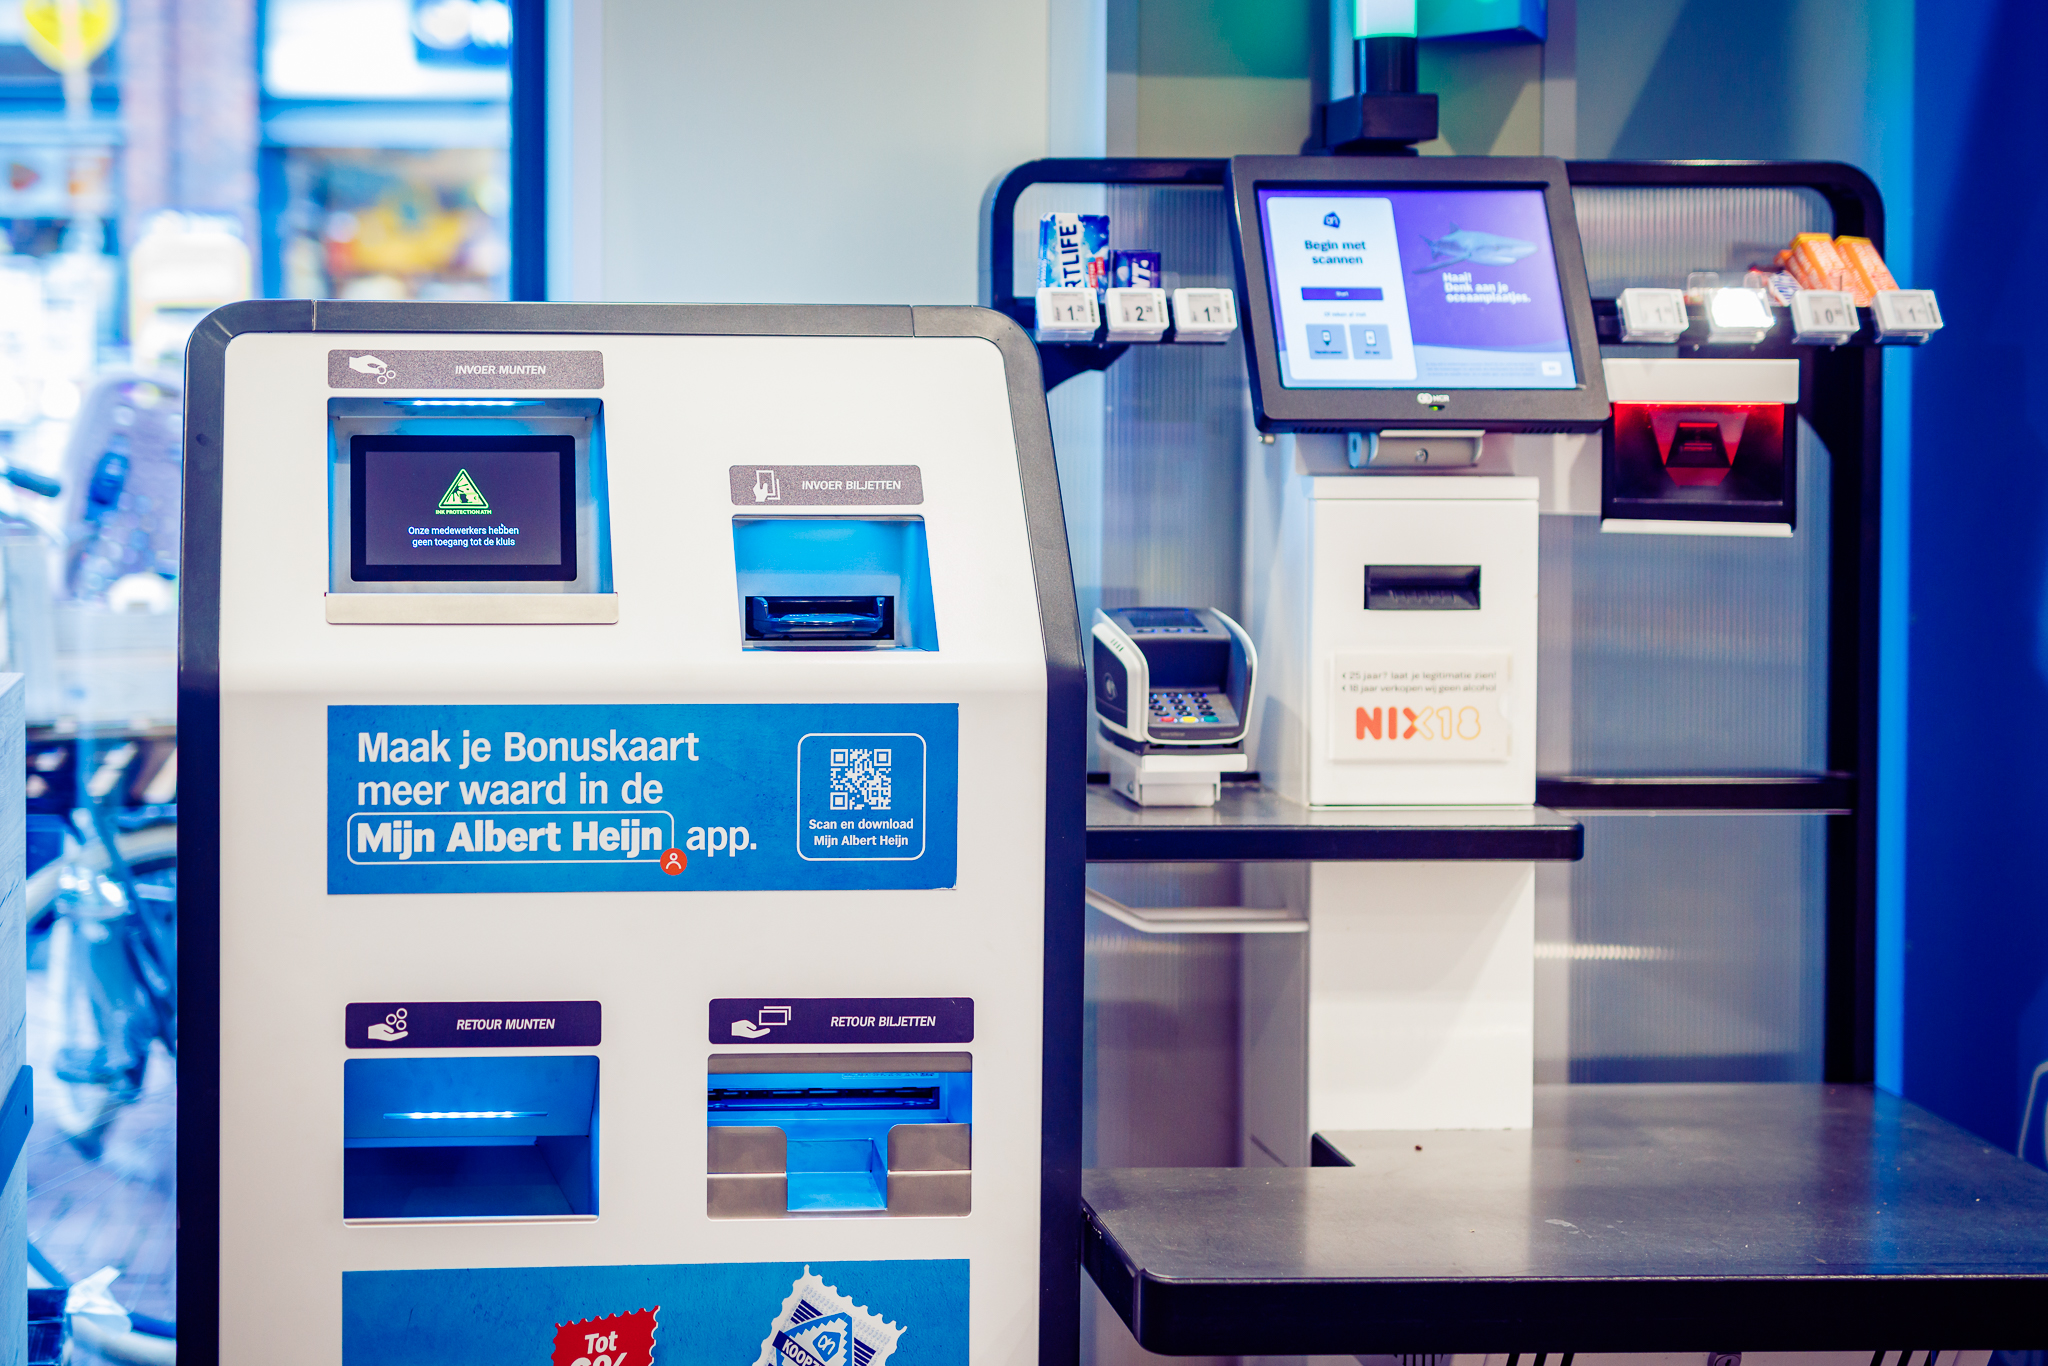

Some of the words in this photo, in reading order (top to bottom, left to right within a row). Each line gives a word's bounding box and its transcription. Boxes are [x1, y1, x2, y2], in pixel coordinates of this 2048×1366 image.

[1304, 239, 1339, 252] Begin
[1342, 240, 1366, 250] met
[1059, 224, 1081, 288] RTLIFE
[1311, 255, 1363, 265] scannen
[1444, 282, 1473, 293] Denk
[1475, 284, 1496, 293] aan
[1496, 282, 1509, 294] je
[1446, 292, 1532, 304] oceaanplaatjes.
[455, 365, 496, 375] INVOER
[499, 365, 546, 375] MUNTEN
[801, 480, 843, 490] INVOER
[845, 480, 901, 490] BILJETTEN
[408, 526, 430, 535] Onze
[431, 526, 487, 535] medewerkers
[488, 526, 520, 535] hebben
[412, 539, 433, 548] geen
[434, 538, 469, 548] toegang
[470, 538, 483, 546] tot
[483, 537, 495, 546] de
[495, 537, 516, 546] kluis
[1350, 671, 1361, 679] 25
[1363, 671, 1388, 681] jaar?
[1391, 671, 1408, 679] laat
[1411, 671, 1420, 681] je
[1423, 671, 1472, 681] legitimatie
[1474, 671, 1497, 679] zien!
[1350, 684, 1359, 692] 18
[1360, 684, 1378, 694] jaar
[1380, 684, 1423, 694] verkopen
[1425, 684, 1437, 694] wij
[1438, 685, 1461, 694] geen
[1463, 684, 1497, 692] alcohol
[1355, 706, 1482, 741] NIX18
[357, 729, 451, 763] Maak
[459, 729, 492, 769] je
[503, 729, 700, 762] Bonuskaart
[357, 780, 450, 806] meer
[459, 772, 567, 805] waard
[579, 772, 608, 805] in
[621, 772, 663, 805] de
[808, 819, 838, 830] Scan
[840, 820, 855, 829] en
[857, 818, 914, 829] download
[357, 819, 435, 860] Mijn
[446, 819, 562, 852] Albert
[573, 819, 663, 858] Heijn
[686, 826, 758, 857] app.
[814, 834, 838, 848] Mijn
[841, 834, 877, 846] Albert
[879, 834, 909, 848] Heijn
[456, 1019, 503, 1031] RETOUR
[505, 1018, 556, 1030] MUNTEN
[830, 1016, 876, 1027] RETOUR
[878, 1015, 937, 1027] BILJETTEN
[584, 1330, 619, 1355] Tot
